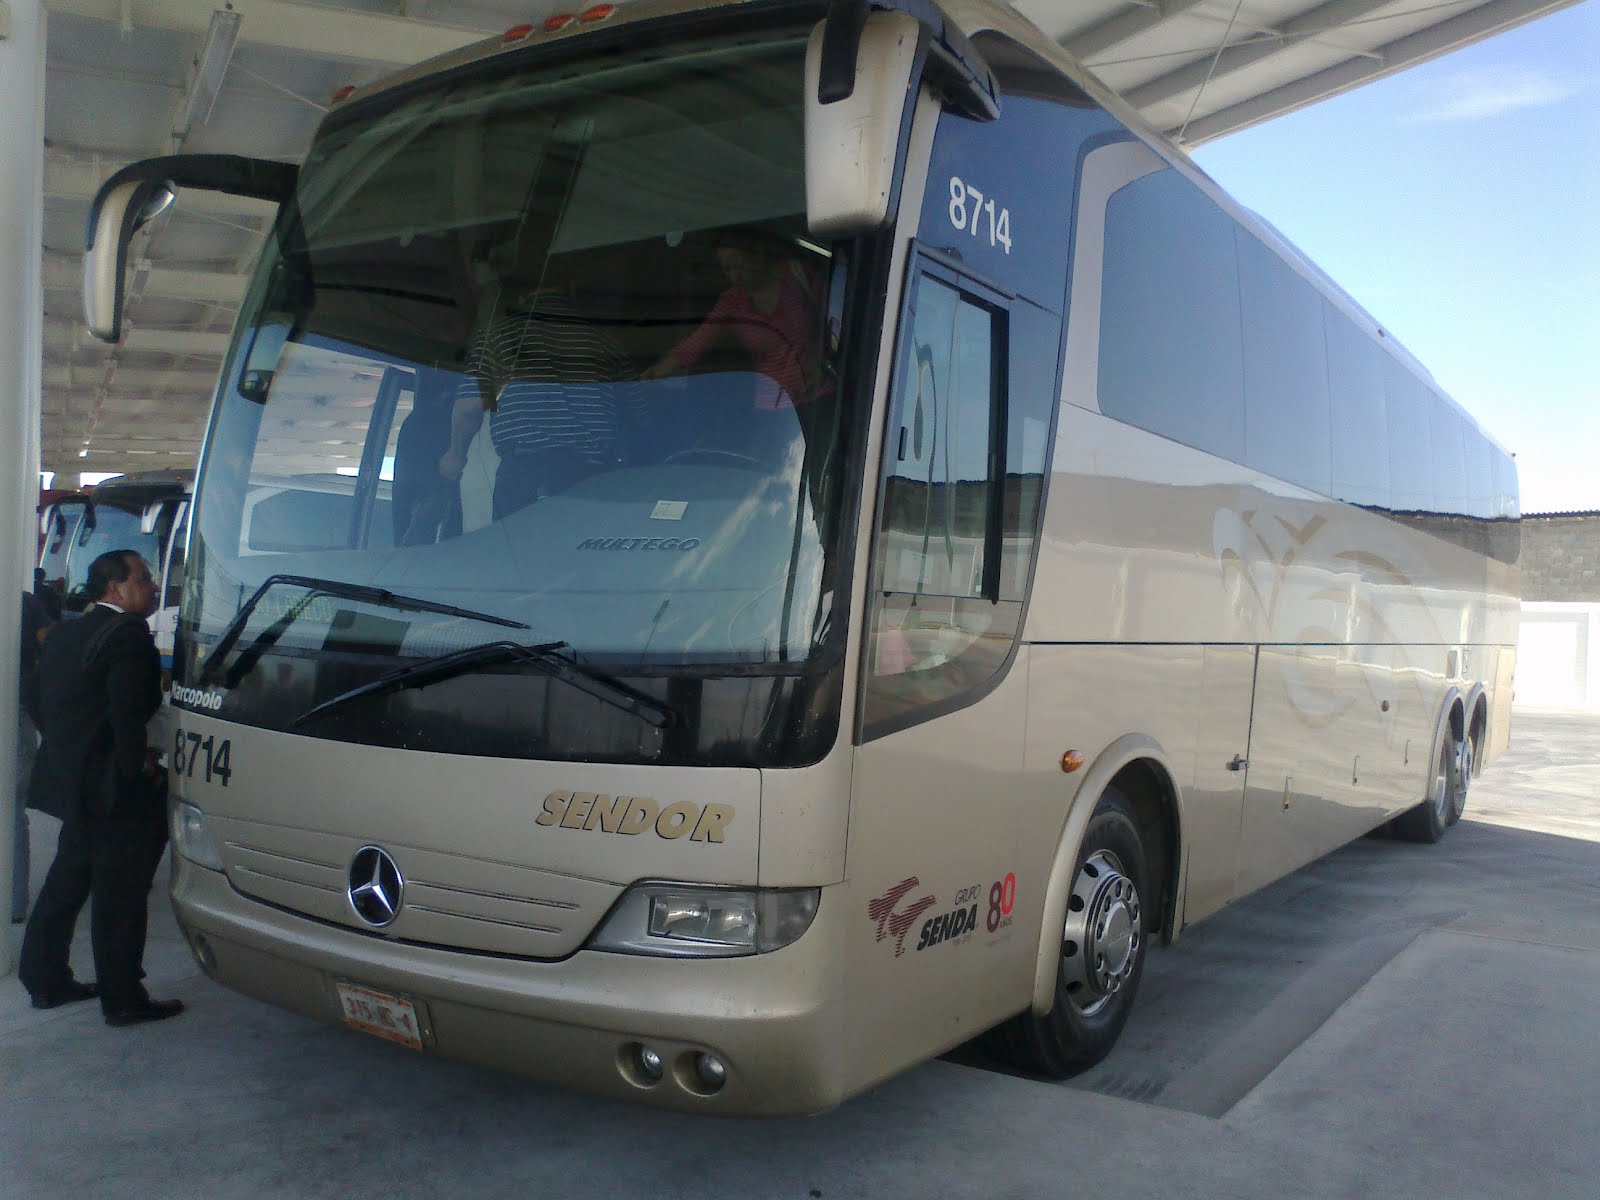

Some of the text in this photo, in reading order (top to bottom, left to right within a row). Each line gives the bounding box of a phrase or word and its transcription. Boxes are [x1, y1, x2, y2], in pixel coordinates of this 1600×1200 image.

[949, 176, 1012, 255] 8714
[576, 537, 700, 551] MULTEGO
[174, 728, 231, 787] 8714
[534, 789, 736, 843] SENDOR
[954, 884, 981, 905] GRUPO
[986, 872, 1016, 933] 80
[916, 903, 978, 951] SENDA
